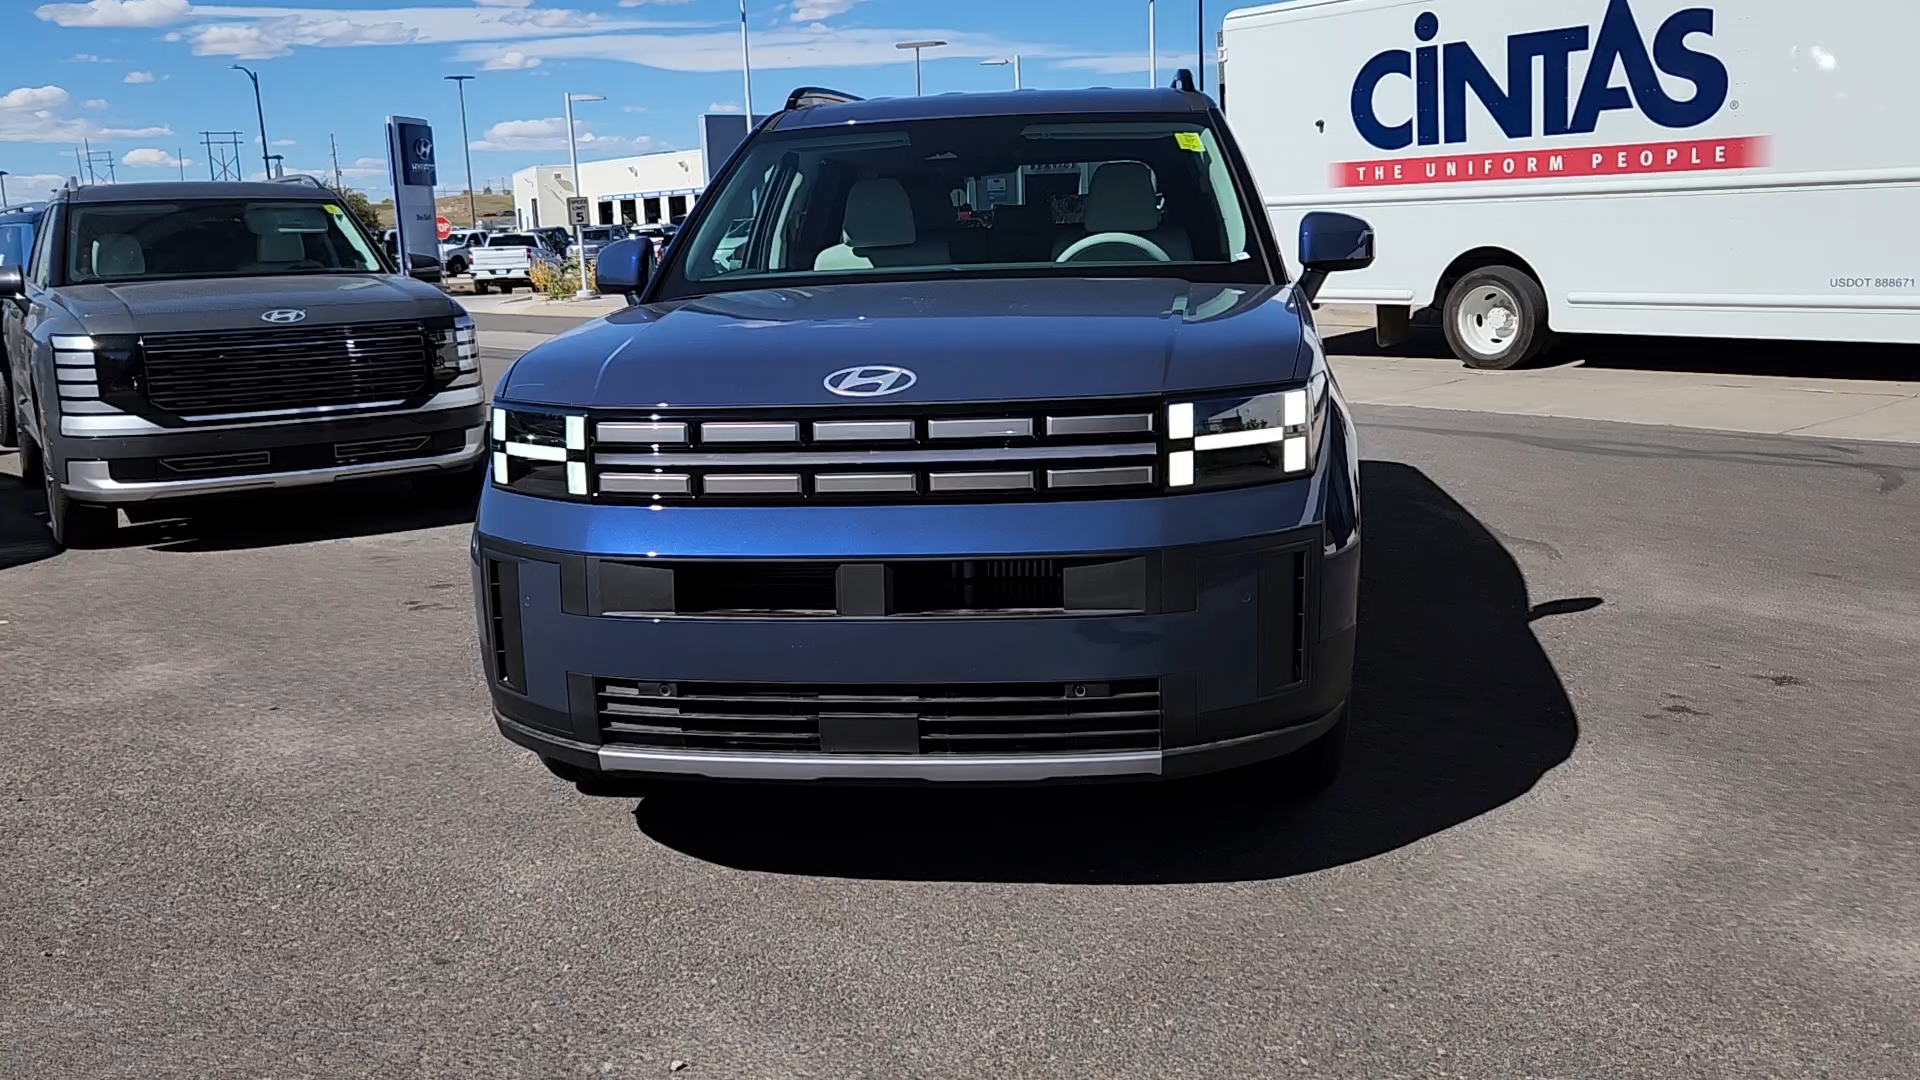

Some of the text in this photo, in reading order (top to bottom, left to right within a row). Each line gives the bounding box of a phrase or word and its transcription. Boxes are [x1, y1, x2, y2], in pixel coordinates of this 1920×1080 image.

[1356, 145, 1726, 181] THE UNIFORM PEOPLE
[576, 212, 584, 222] 5
[1829, 277, 1915, 288] USDOT 888671
